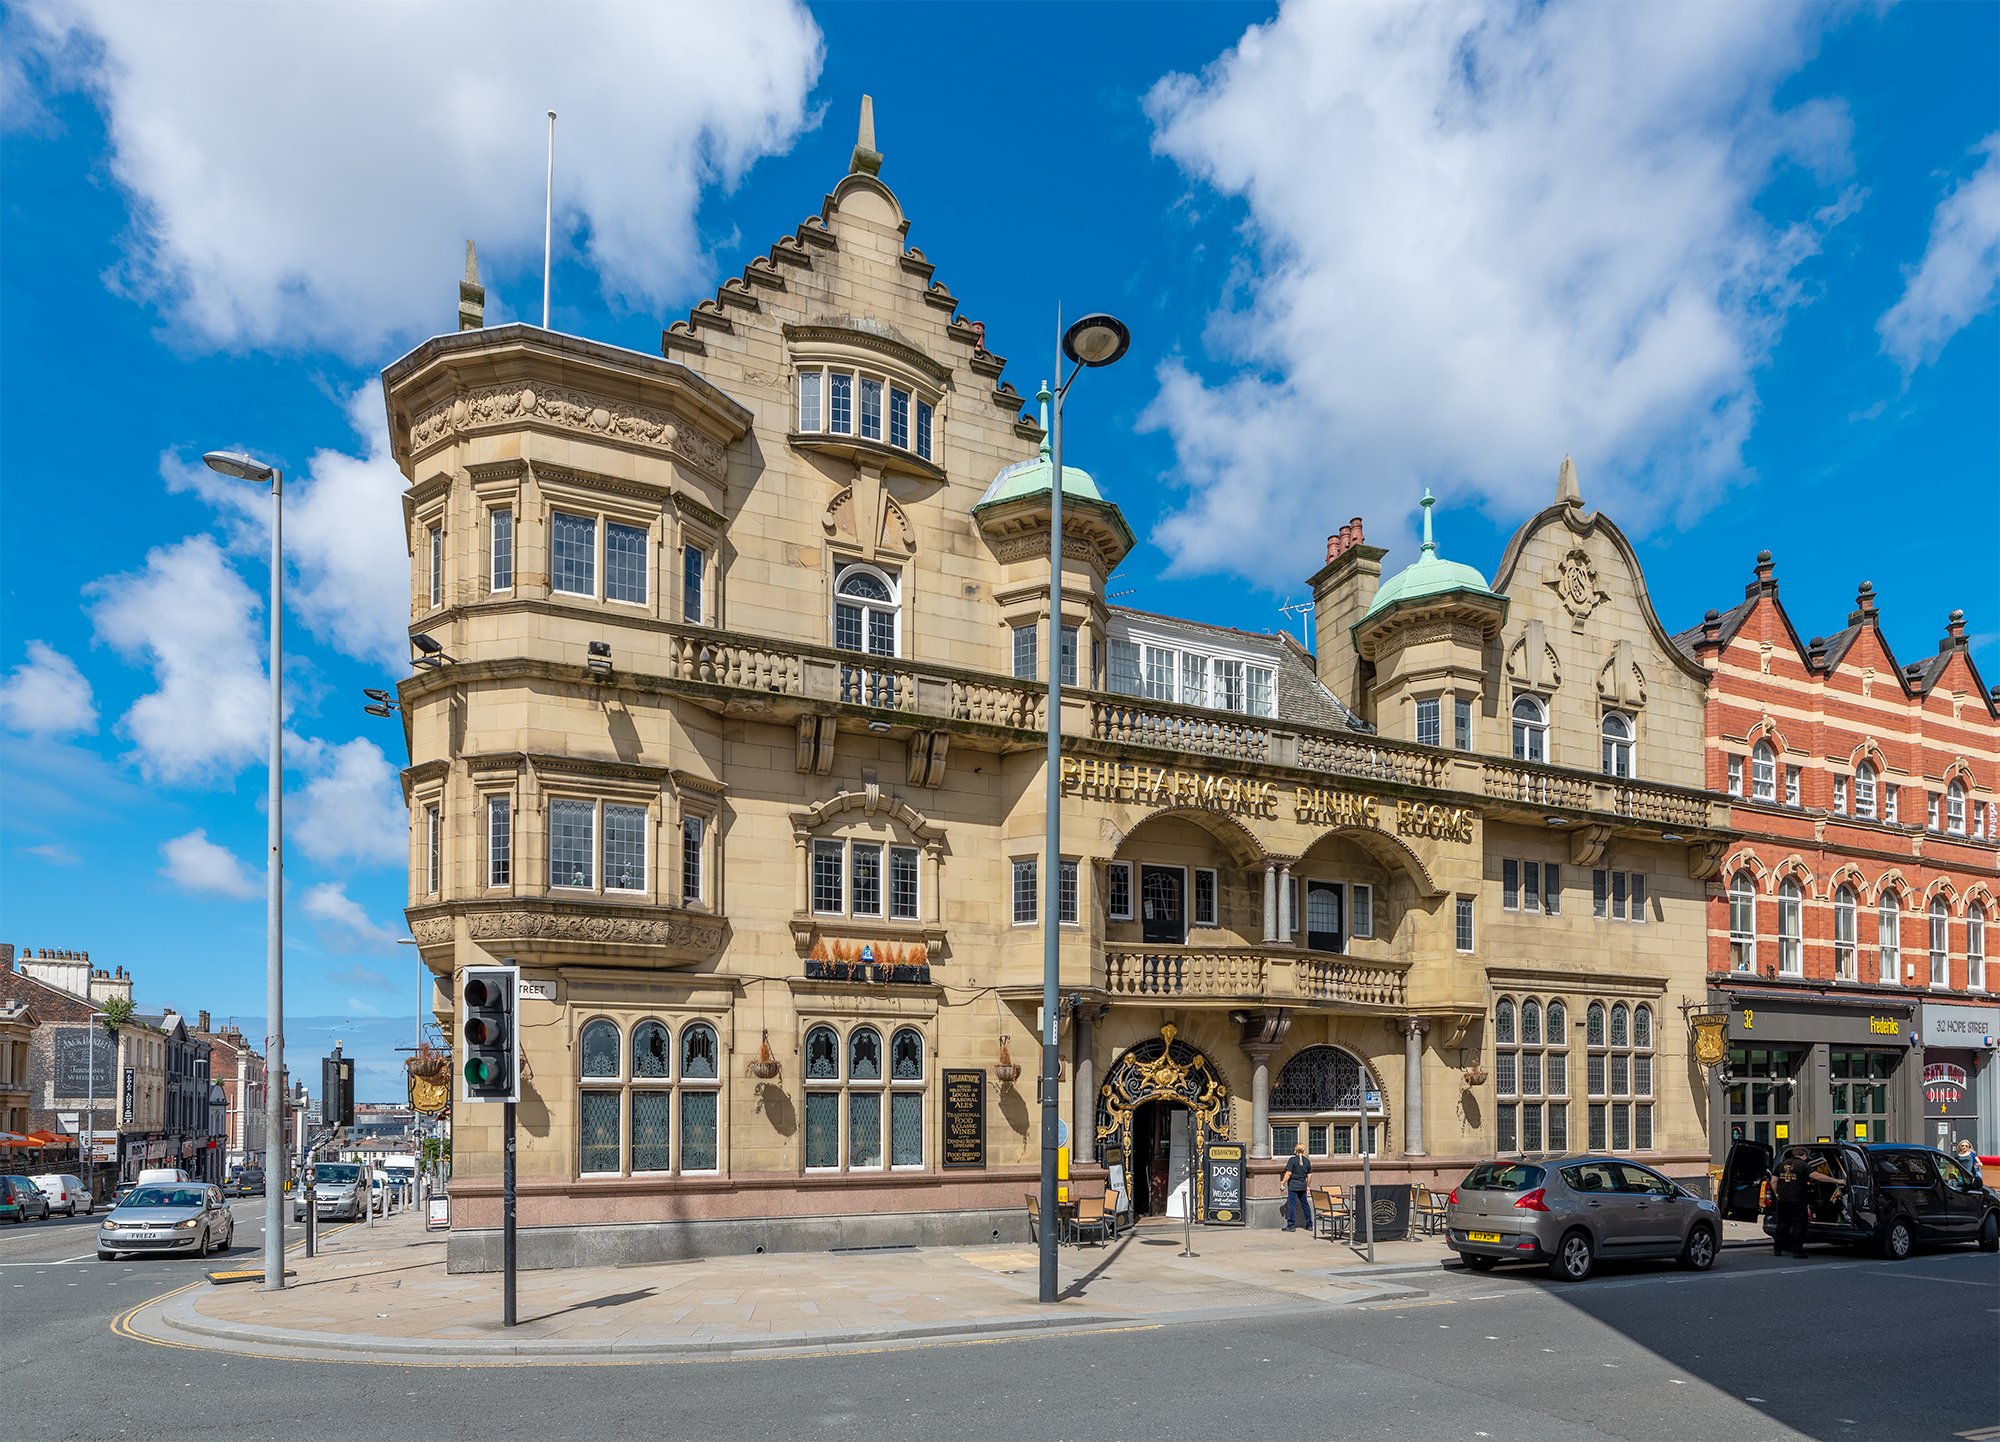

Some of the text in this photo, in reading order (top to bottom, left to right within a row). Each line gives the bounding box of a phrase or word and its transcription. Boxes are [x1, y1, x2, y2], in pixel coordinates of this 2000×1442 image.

[1060, 757, 1474, 833] PHILHARMONIC DINING ROOMS
[519, 985, 545, 993] TREET
[1743, 1009, 1754, 1029] 32
[1870, 1016, 1899, 1035] Frederiks
[1936, 1019, 1989, 1034] 32 HOPE STREET
[1924, 1064, 1964, 1085] EATH ROW
[1930, 1088, 1958, 1102] DINER
[1213, 1166, 1239, 1177] DOGS
[1212, 1188, 1239, 1198] WELCOME
